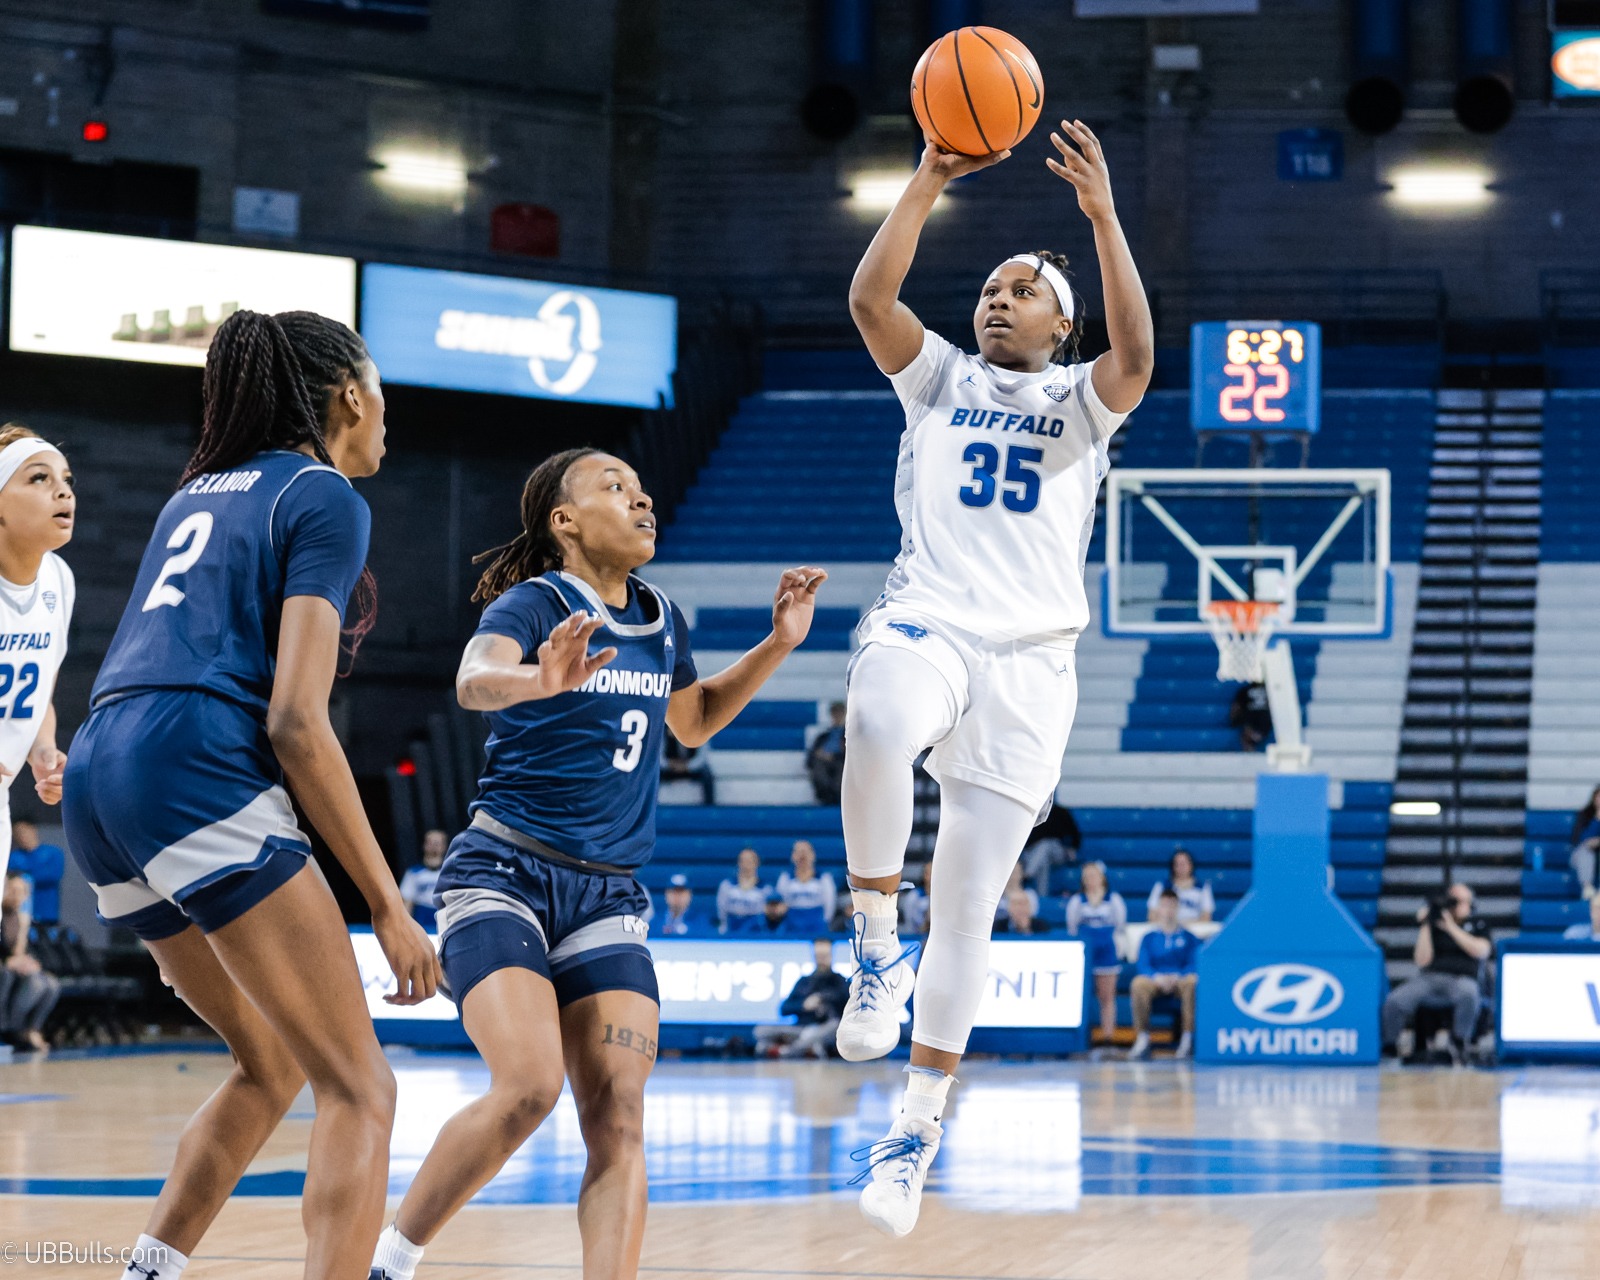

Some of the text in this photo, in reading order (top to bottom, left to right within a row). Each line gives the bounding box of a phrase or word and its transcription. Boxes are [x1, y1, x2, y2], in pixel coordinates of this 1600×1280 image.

[1227, 329, 1304, 365] 6:27
[1219, 363, 1290, 422] 22
[947, 407, 1065, 439] BUFFALO
[958, 440, 1045, 515] 35
[141, 511, 214, 613] 2
[0, 632, 51, 651] UFFALO
[612, 709, 649, 773] 3
[1216, 1027, 1359, 1056] HYUNDAI
